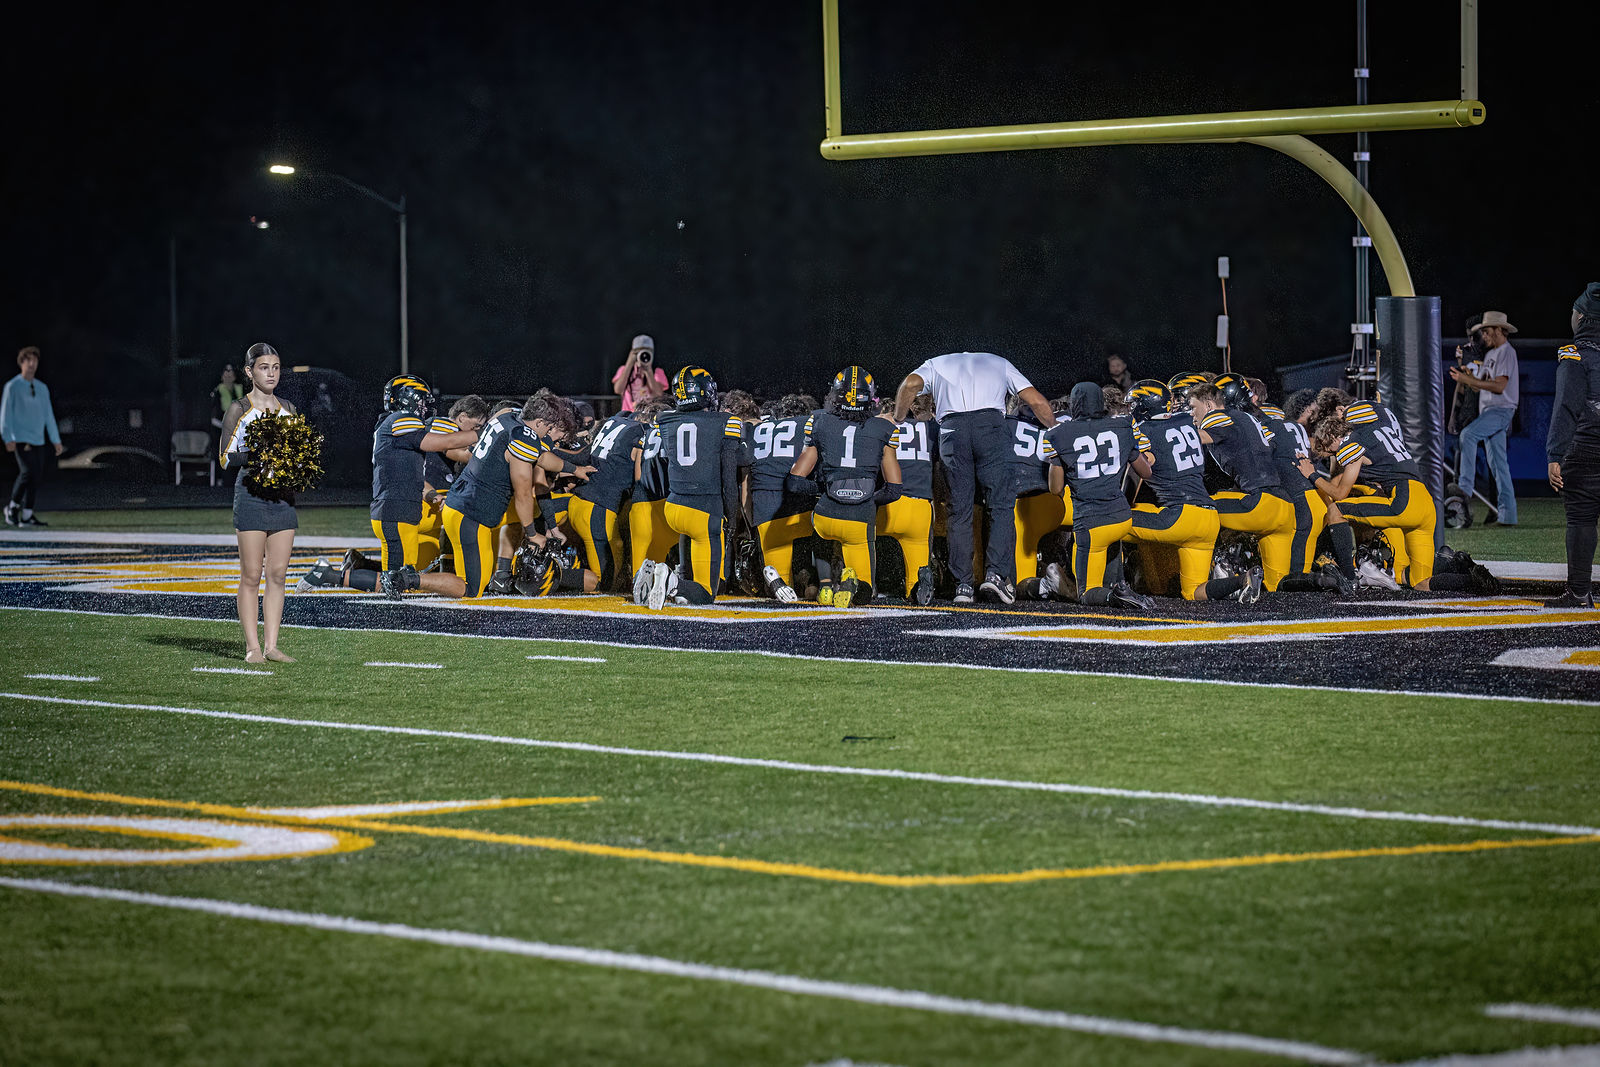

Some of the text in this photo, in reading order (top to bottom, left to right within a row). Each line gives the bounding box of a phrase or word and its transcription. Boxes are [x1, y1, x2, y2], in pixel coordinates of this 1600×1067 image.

[523, 425, 538, 440] 55
[590, 419, 626, 460] 64
[677, 422, 698, 467] 0
[753, 420, 798, 460] 92
[840, 425, 857, 468] 1
[896, 421, 931, 462] 21
[1165, 424, 1205, 472] 29
[1073, 430, 1121, 479] 23
